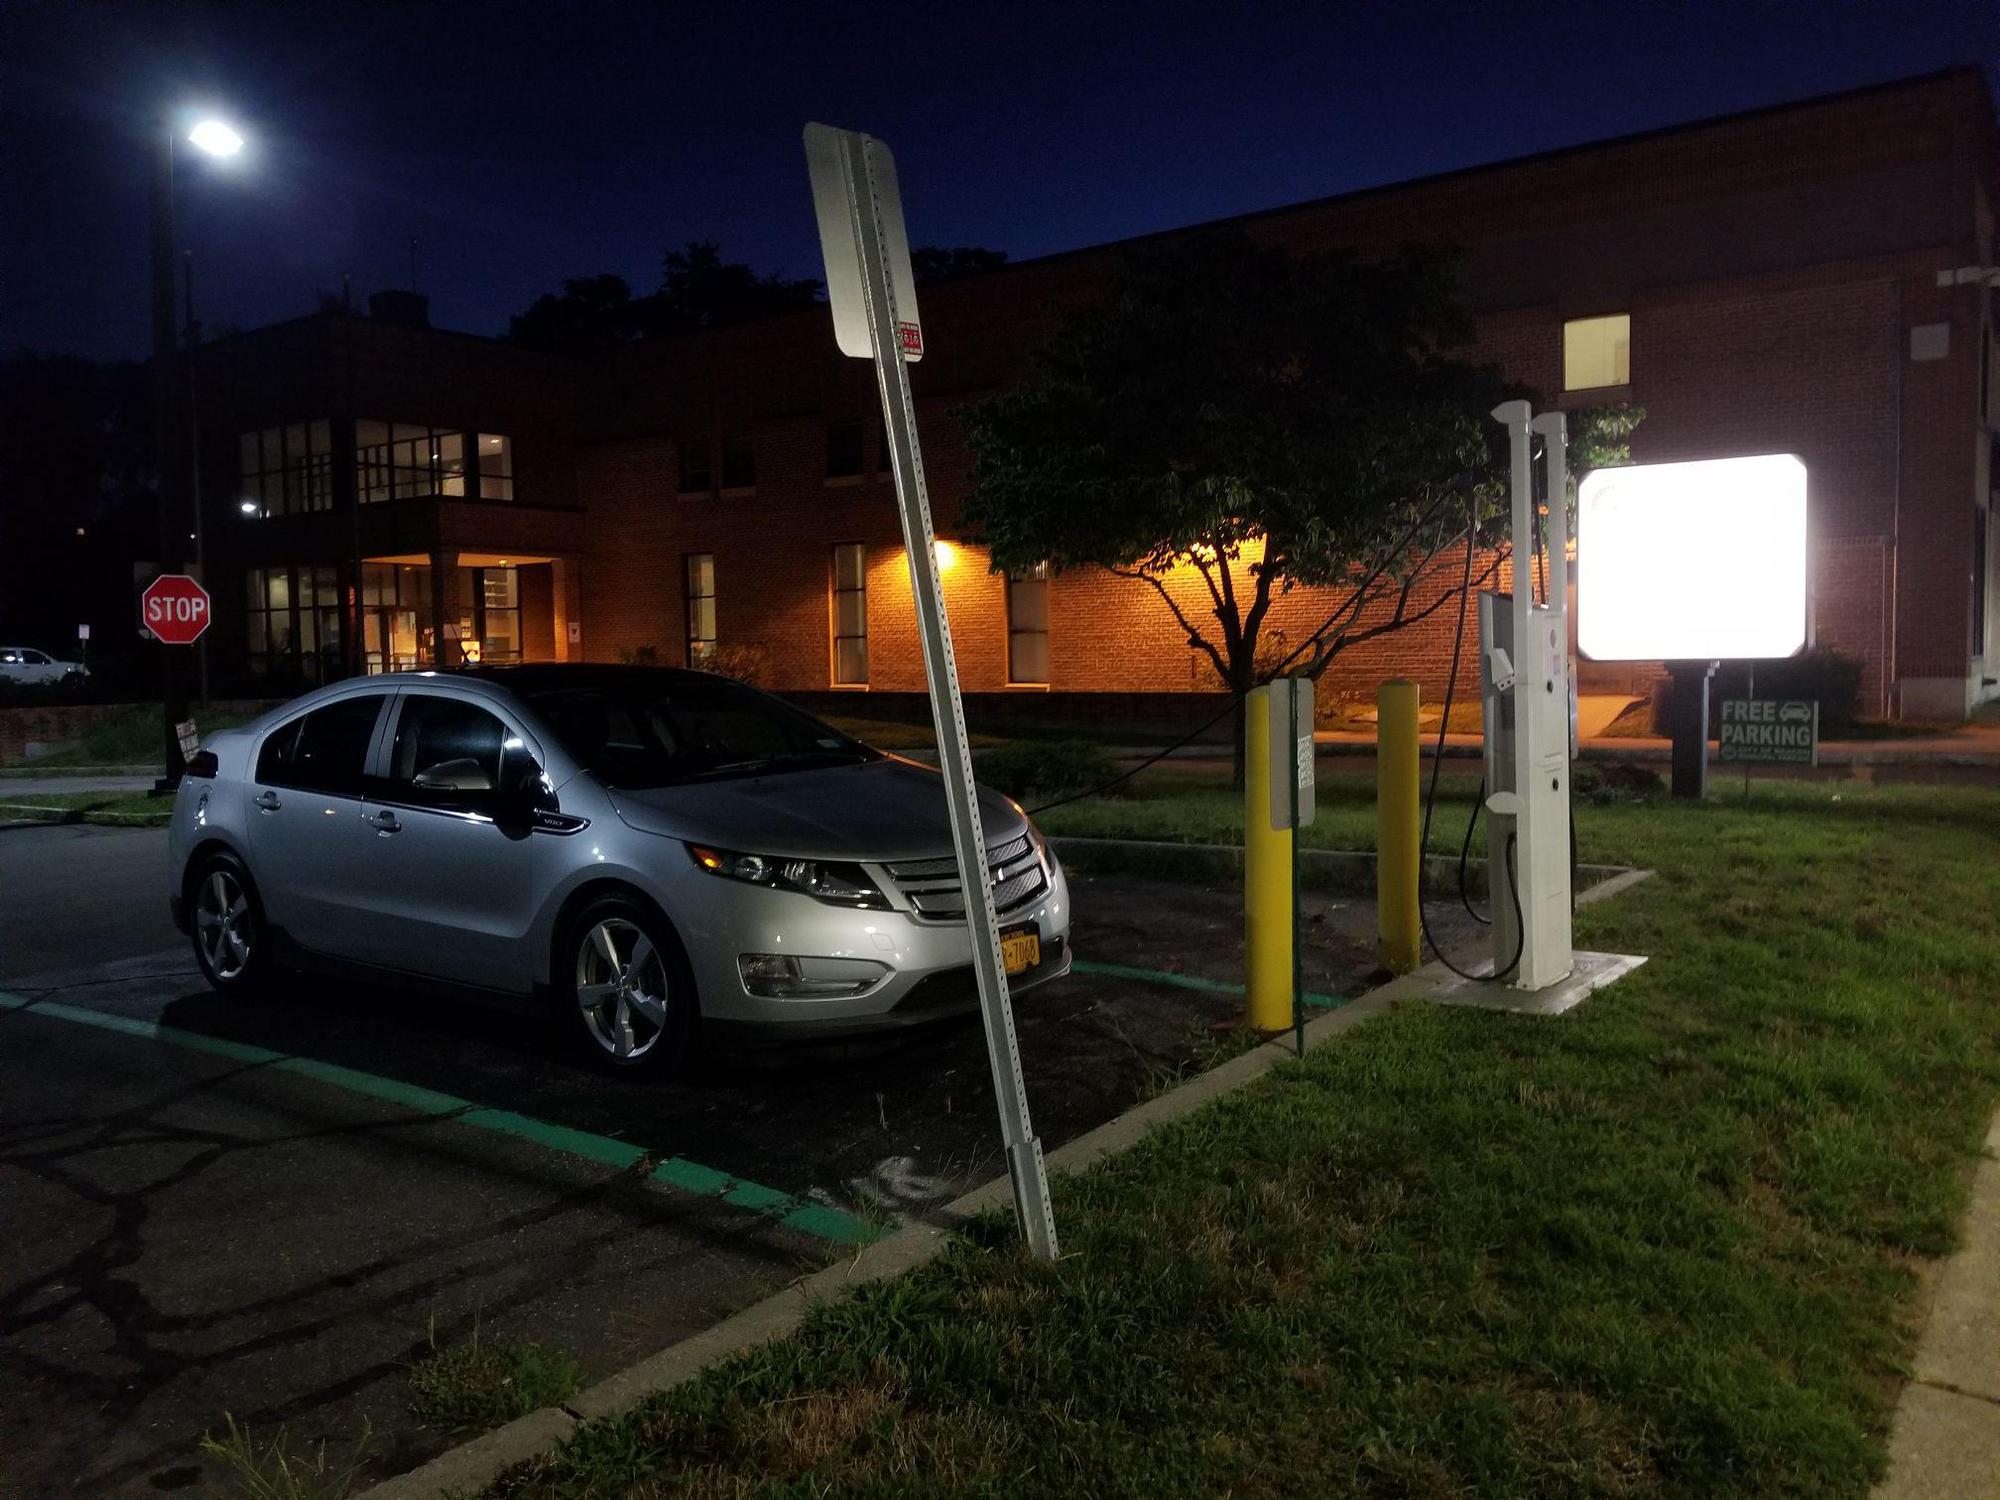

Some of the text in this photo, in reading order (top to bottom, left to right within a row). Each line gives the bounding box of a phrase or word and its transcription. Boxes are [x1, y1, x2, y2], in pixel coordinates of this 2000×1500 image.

[149, 596, 206, 622] STOP
[1722, 701, 1776, 721] FREE
[1720, 723, 1811, 746] PARKING
